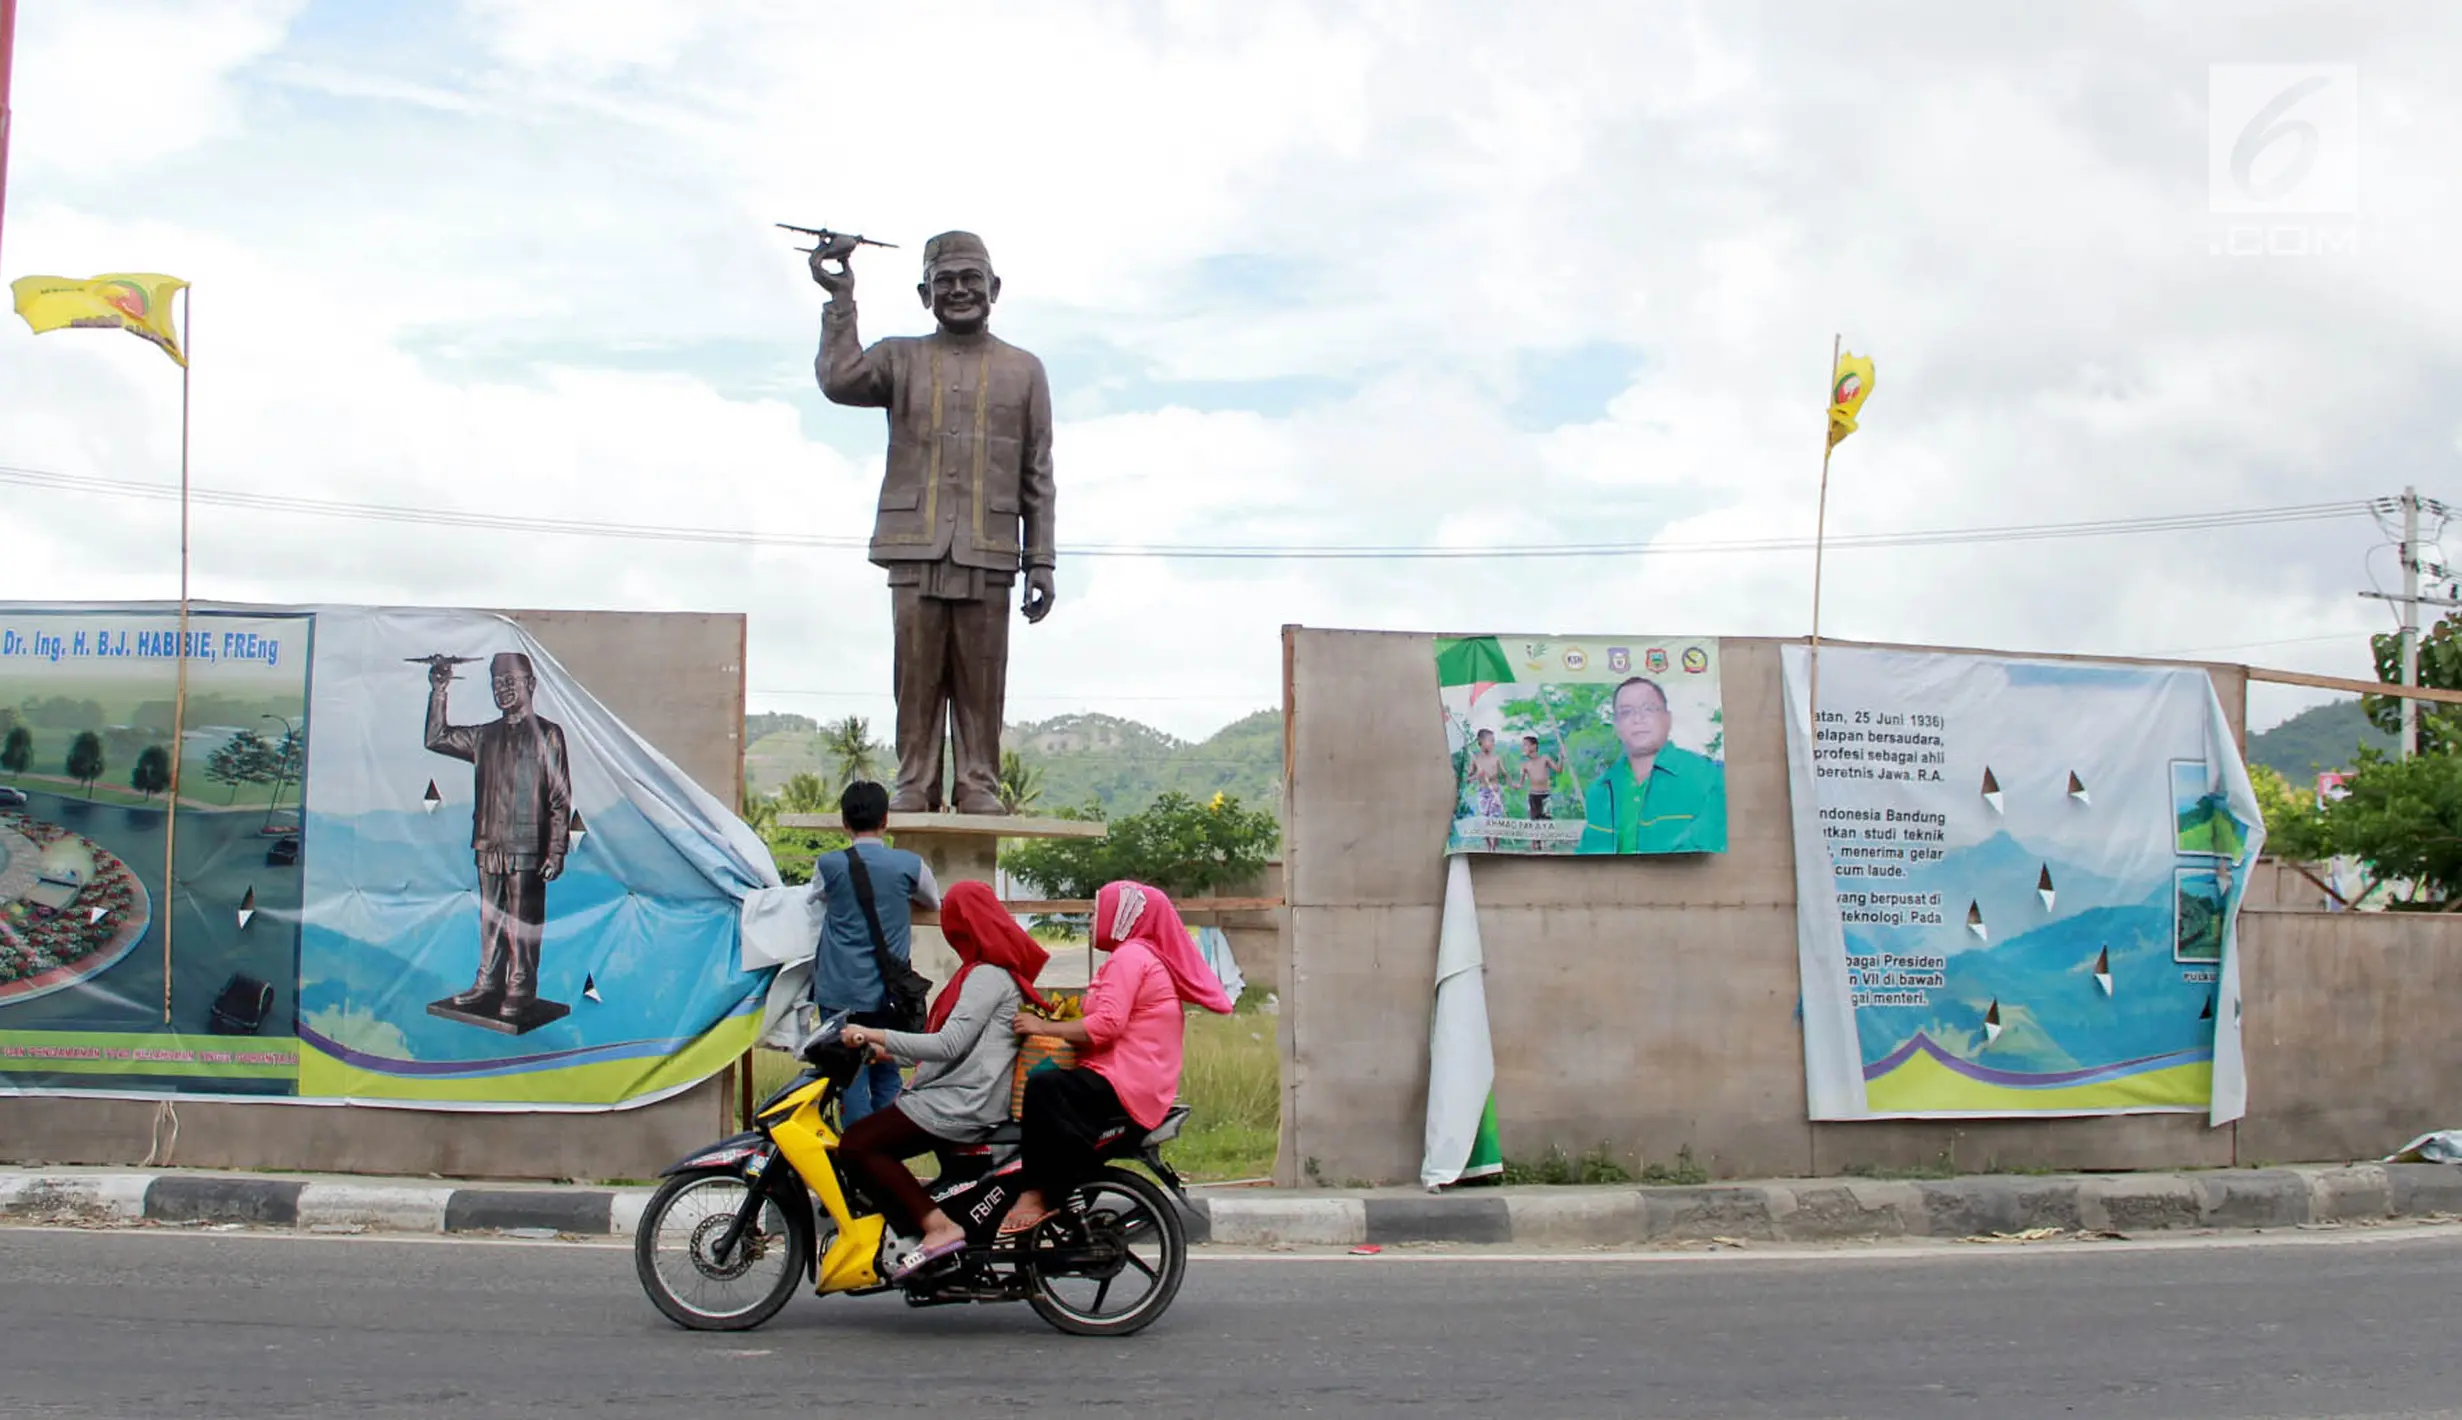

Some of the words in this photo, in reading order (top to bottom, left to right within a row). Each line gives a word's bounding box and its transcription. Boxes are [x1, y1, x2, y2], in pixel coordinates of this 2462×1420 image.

[3, 630, 27, 656] Dr.
[34, 630, 66, 662] Ing.
[73, 631, 90, 656] H.
[97, 631, 130, 657] B.J.
[138, 631, 216, 663] HABIBIE,
[223, 632, 279, 665] FREng
[1855, 711, 1870, 724] 25
[1876, 712, 1904, 725] Juni
[1911, 713, 1945, 731] 1936)
[1868, 730, 1944, 747] bersaudara,
[1813, 748, 1864, 762] profesi
[1867, 750, 1918, 766] sebagai
[1921, 750, 1945, 764] ahli
[1817, 765, 1874, 779] beretnis
[1877, 768, 1914, 781] Jawa.
[1918, 769, 1945, 782] R.A.
[1819, 808, 1881, 821] ndonesia
[1886, 809, 1946, 826] Bandung
[1864, 827, 1897, 840] studi
[1904, 829, 1945, 842] teknik
[1841, 846, 1904, 859] menerima
[1910, 847, 1944, 863] gelar
[1835, 865, 1864, 876] cum
[1868, 864, 1907, 877] laude.
[1871, 892, 1926, 907] berpusat
[1929, 893, 1941, 905] di
[1911, 911, 1942, 923] Pada
[1884, 955, 1944, 968] Presiden
[1863, 974, 1879, 985] VII
[1884, 974, 1895, 985] di
[1899, 974, 1943, 985] bawah
[1874, 992, 1927, 1004] menteri.
